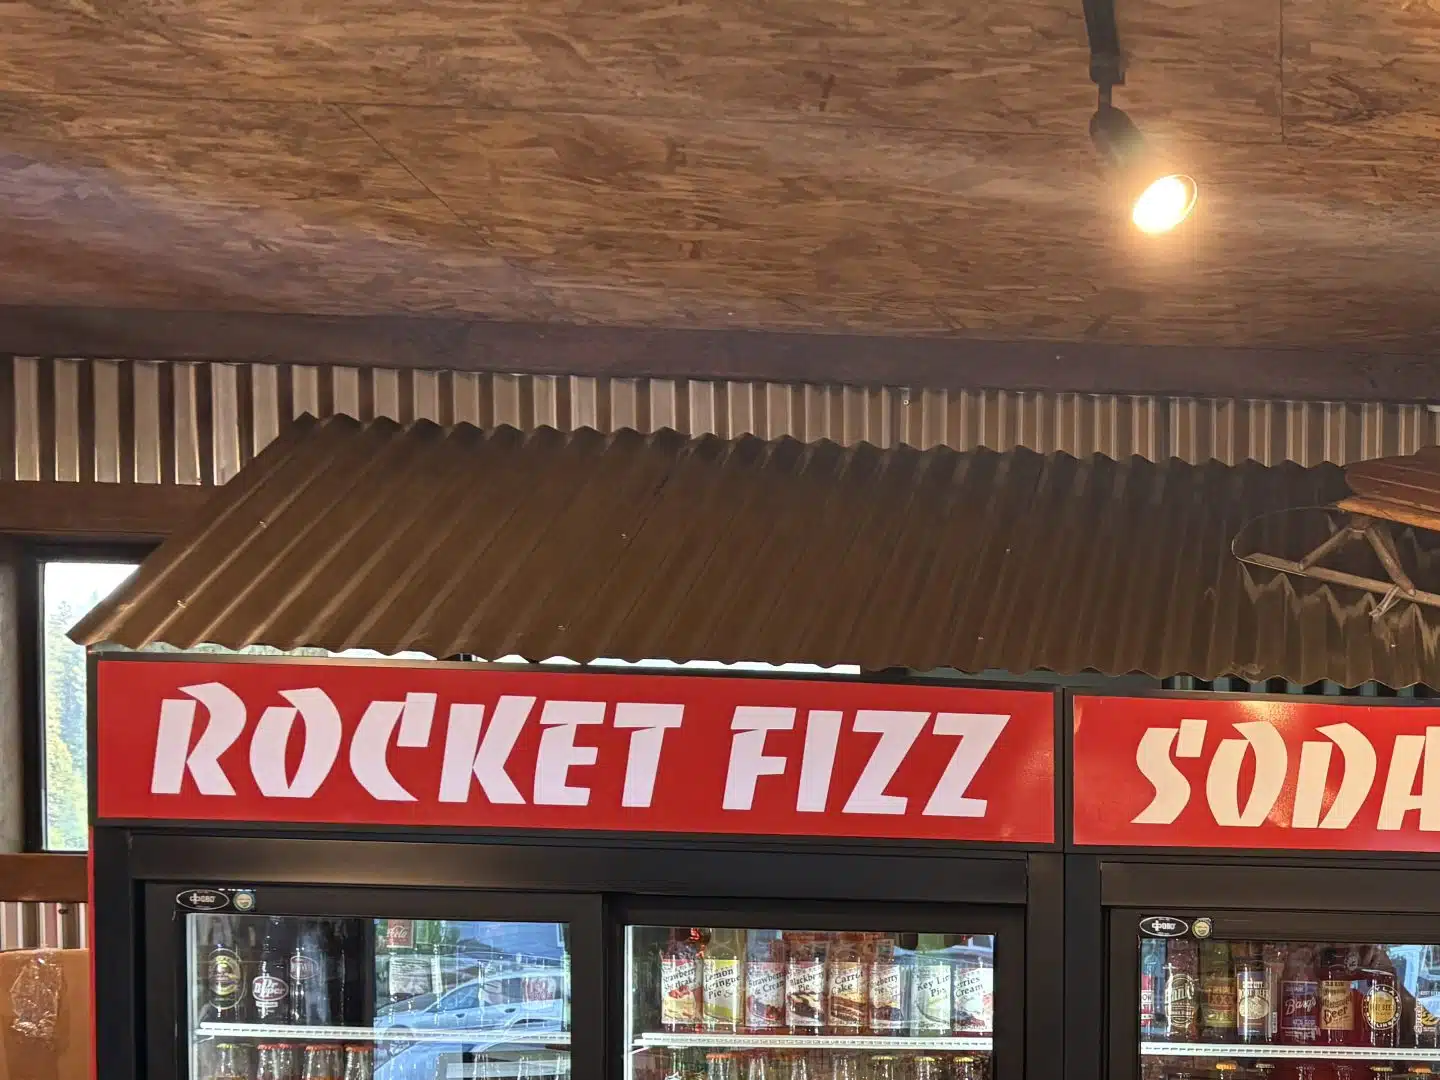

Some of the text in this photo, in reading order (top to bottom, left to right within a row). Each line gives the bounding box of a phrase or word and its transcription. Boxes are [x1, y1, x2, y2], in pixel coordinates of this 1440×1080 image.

[151, 681, 1011, 818] ROCKET FIZZ
[704, 967, 734, 982] Lemon
[708, 988, 722, 999] Pie
[798, 983, 811, 992] Pie
[832, 982, 853, 996] Cake
